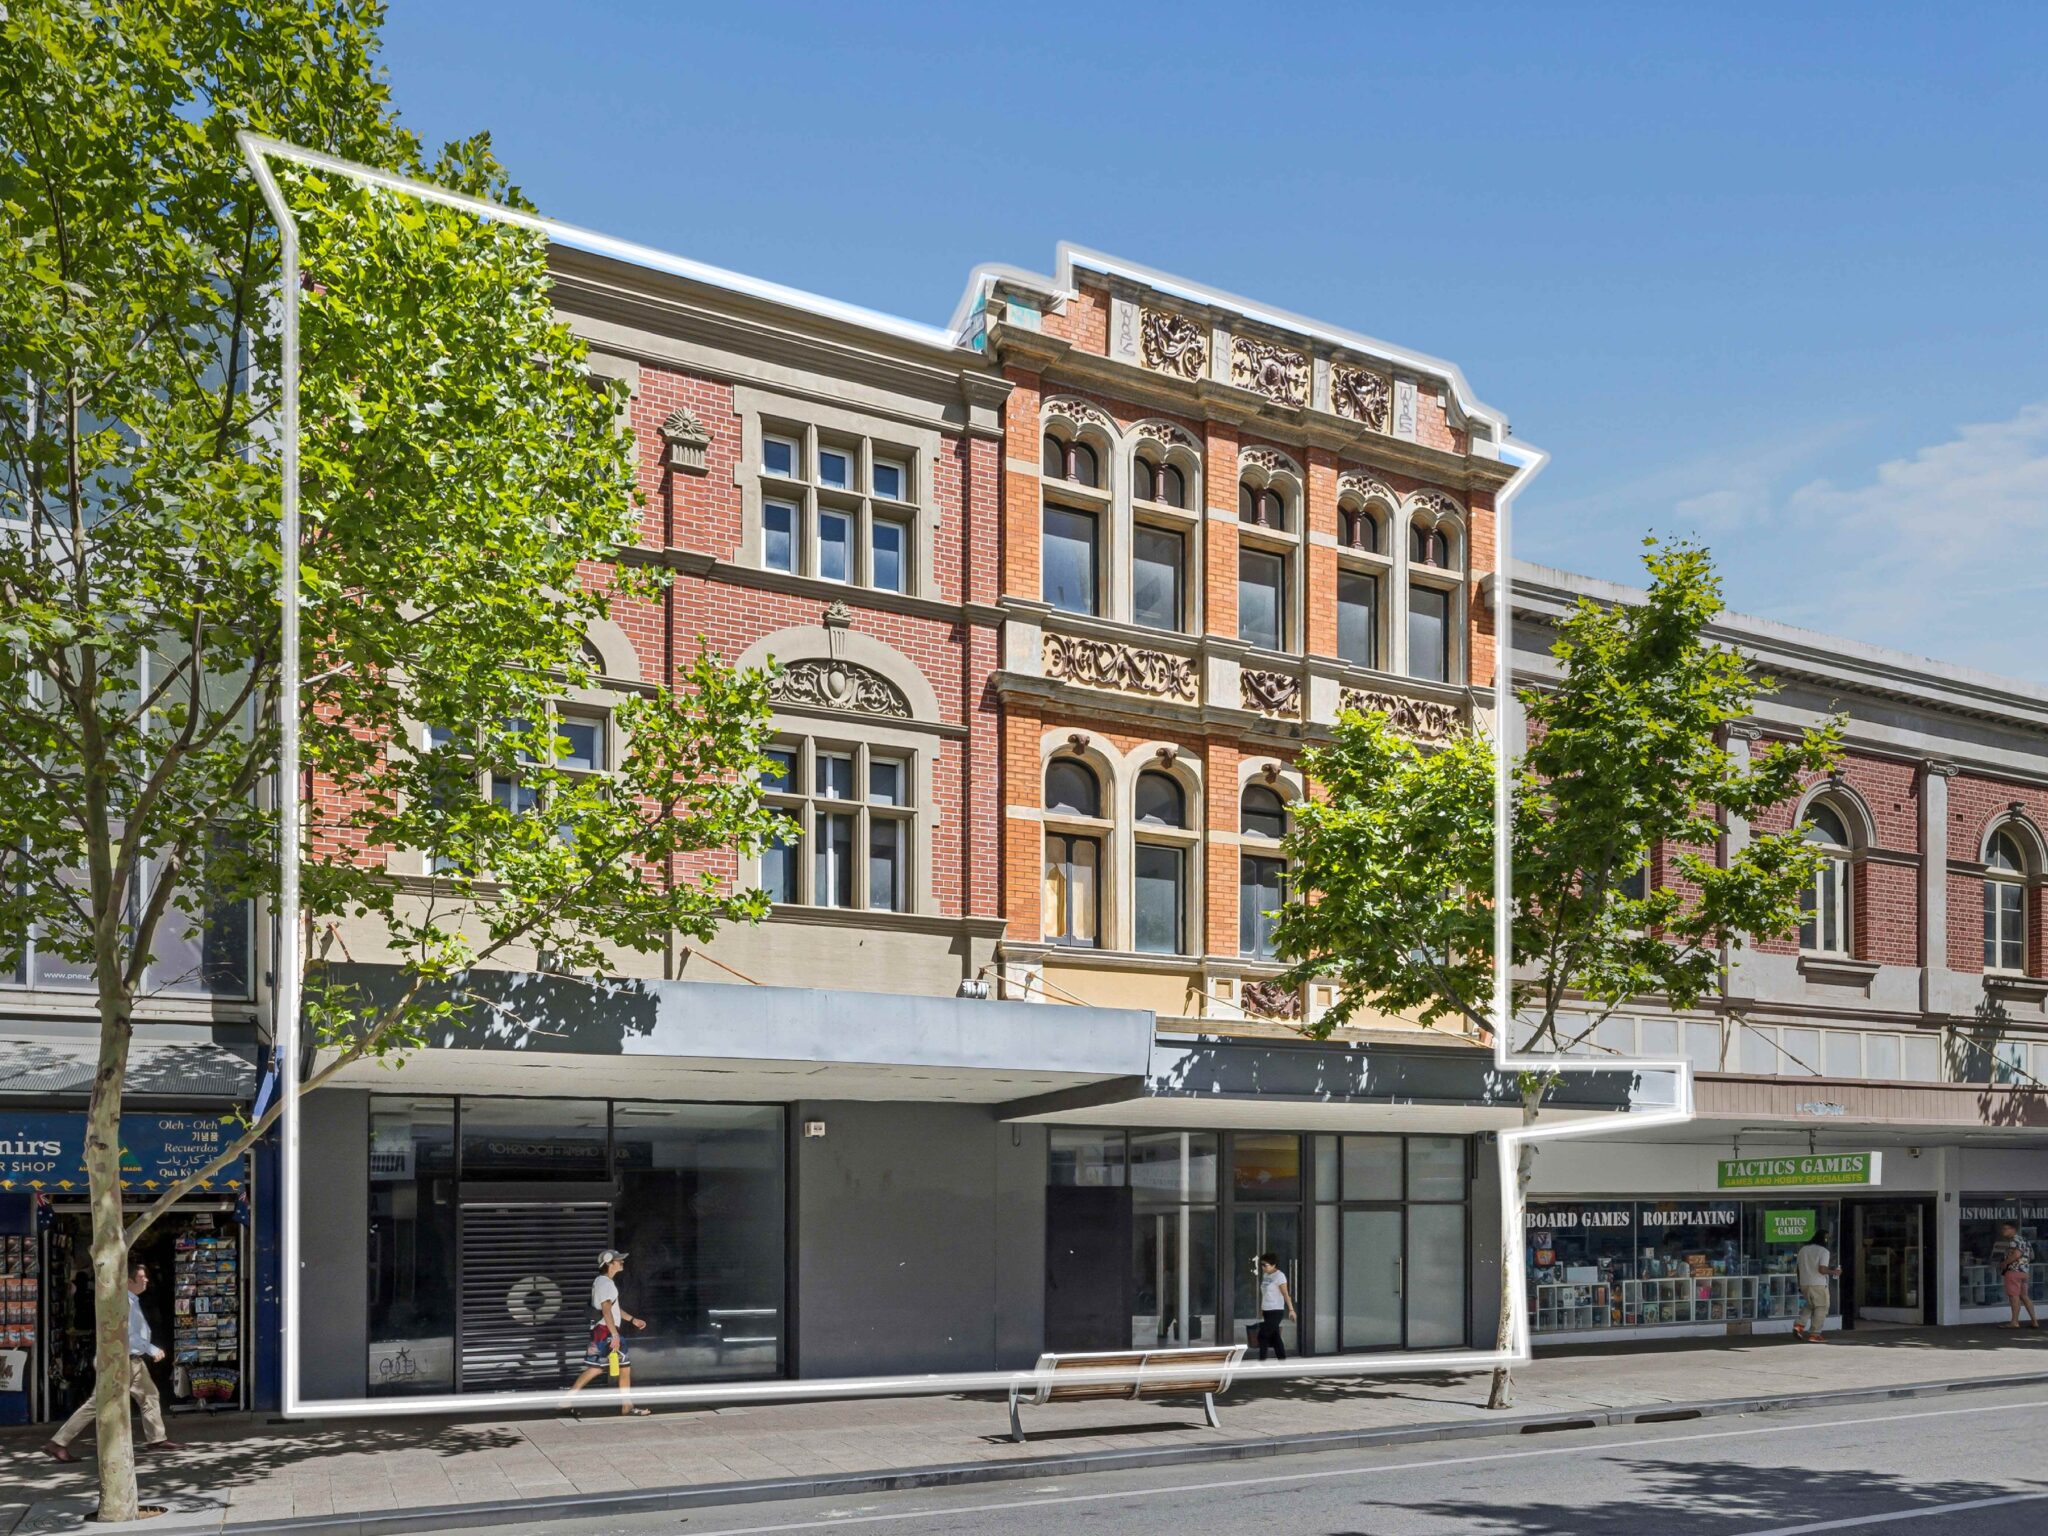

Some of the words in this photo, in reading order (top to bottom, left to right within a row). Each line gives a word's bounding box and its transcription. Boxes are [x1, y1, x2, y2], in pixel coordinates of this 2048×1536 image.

[158, 1120, 184, 1130] Oleh
[193, 1120, 218, 1130] Oleh
[164, 1143, 218, 1152] Recuerdos
[12, 1162, 56, 1172] SHOP
[1725, 1160, 1795, 1177] TACTICS
[1801, 1157, 1863, 1174] GAMES
[1725, 1177, 1755, 1186] GAMES
[1755, 1176, 1772, 1185] AND
[1774, 1175, 1802, 1184] HOBBY
[1806, 1173, 1863, 1183] SPECIALISTS
[1526, 1212, 1578, 1228] BOARD
[1581, 1211, 1630, 1226] GAMES
[1643, 1210, 1735, 1226] ROLEPLAYING
[1774, 1217, 1808, 1227] TACTICS
[1777, 1226, 1804, 1236] GAMES
